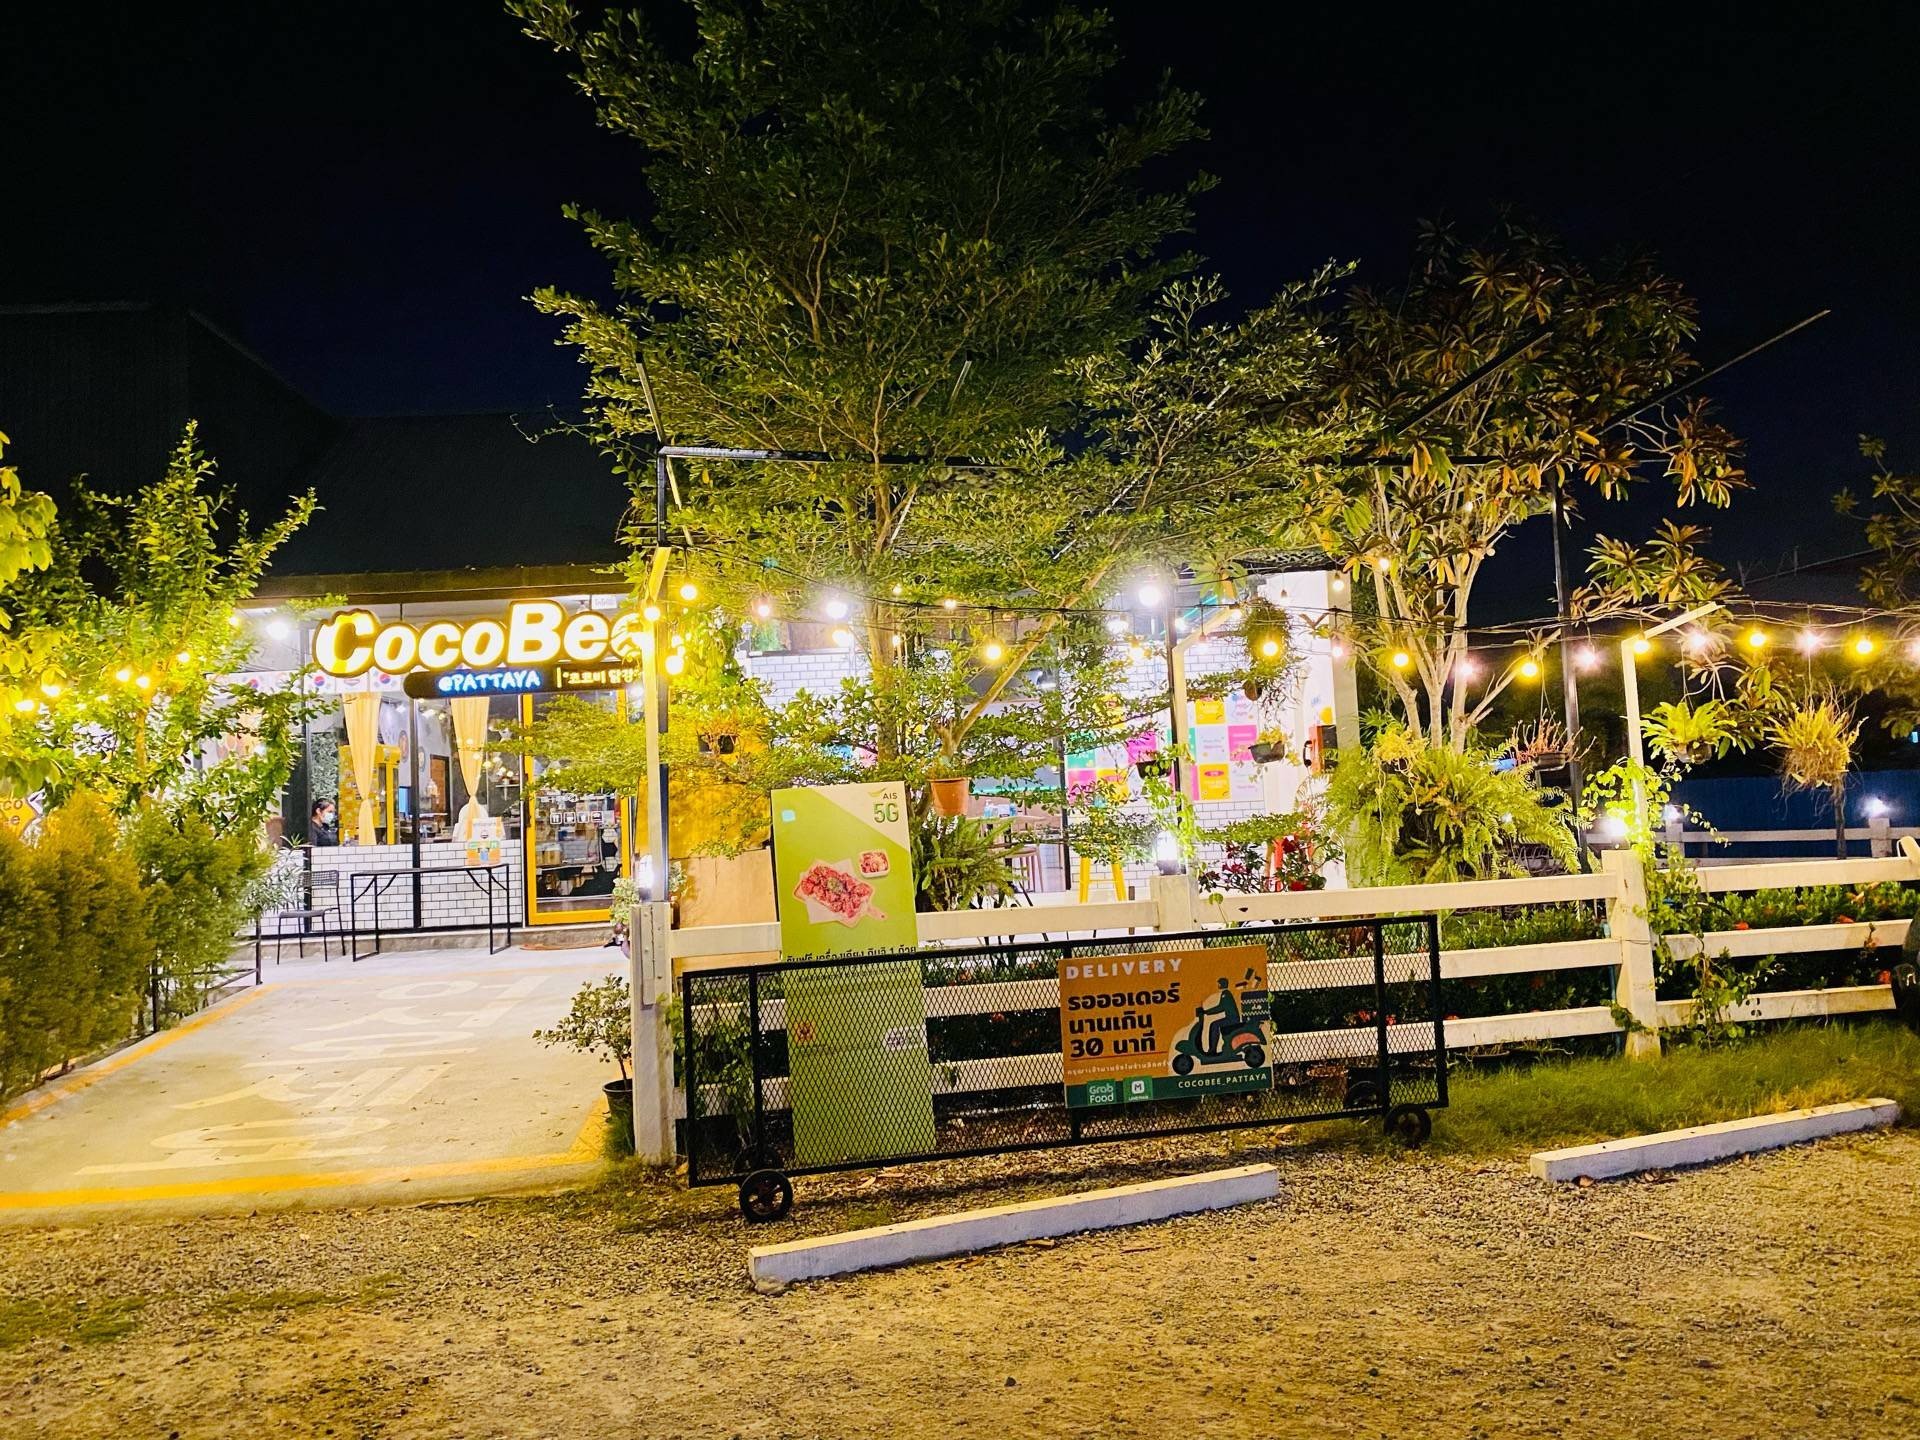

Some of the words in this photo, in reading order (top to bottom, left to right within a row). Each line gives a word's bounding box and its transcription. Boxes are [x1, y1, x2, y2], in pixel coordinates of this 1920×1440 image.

[882, 792, 898, 800] AIS
[874, 803, 899, 823] 5G
[1066, 958, 1182, 979] DELIVERY
[1068, 982, 1180, 1011] รอออเดอร์
[1069, 1010, 1153, 1034] นานเกิน
[1070, 1037, 1104, 1058] 30
[1113, 1030, 1156, 1054] นาที
[1089, 1083, 1114, 1095] Grab
[1178, 1073, 1267, 1089] COCOBEE_PATTAYA
[1089, 1094, 1114, 1104] Food
